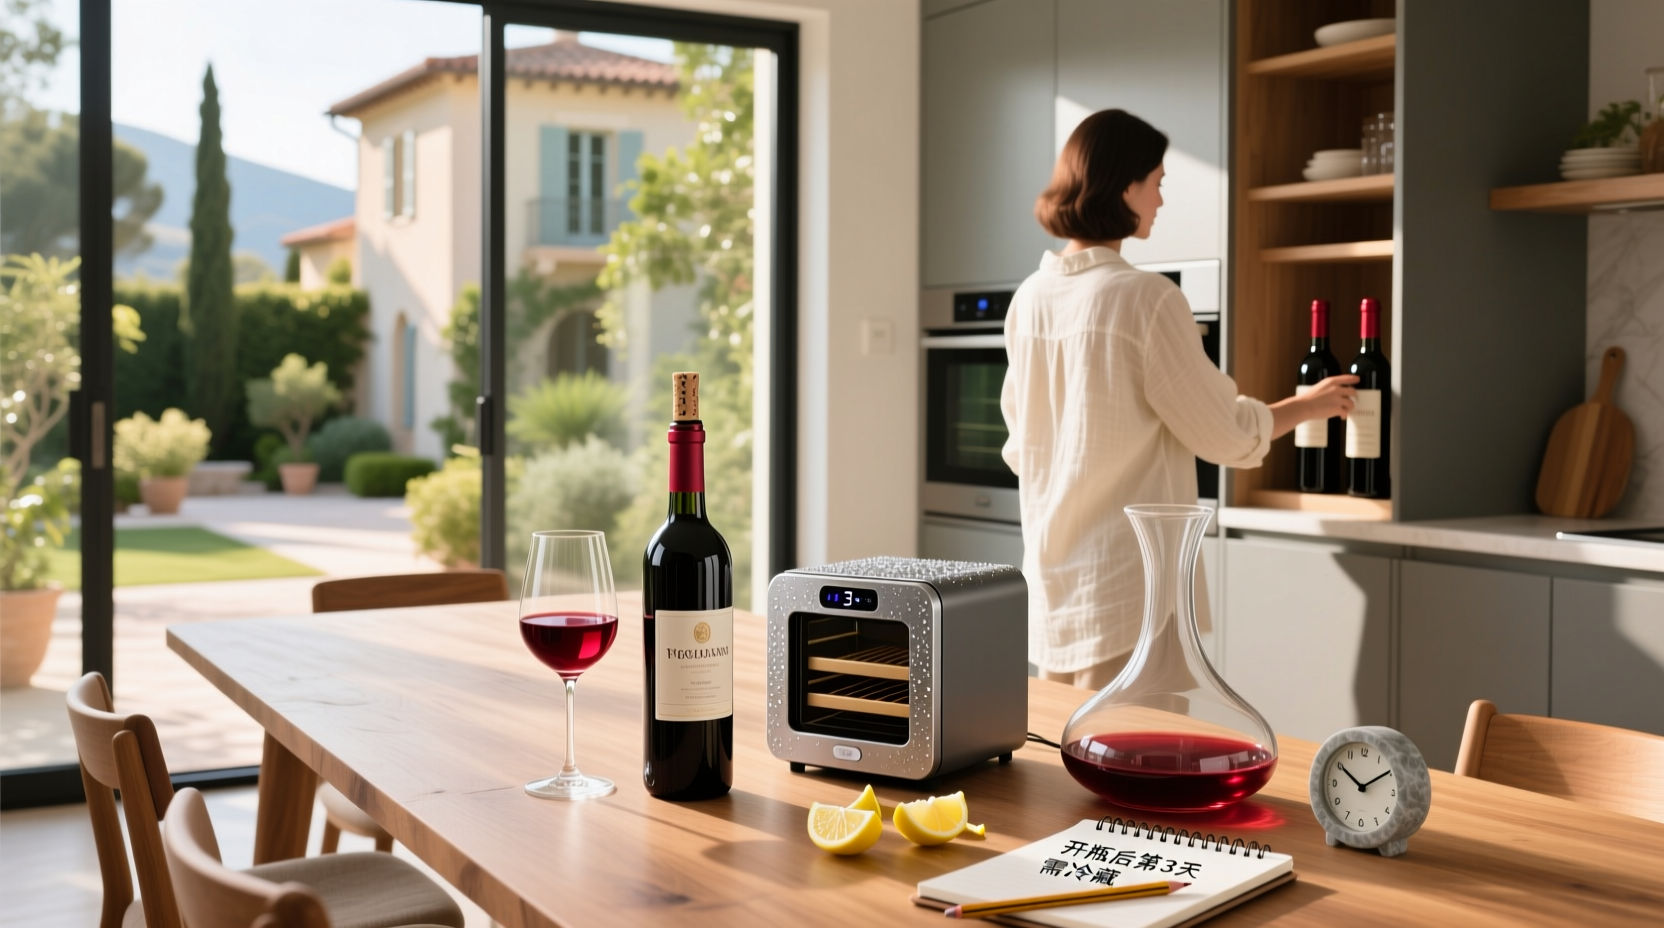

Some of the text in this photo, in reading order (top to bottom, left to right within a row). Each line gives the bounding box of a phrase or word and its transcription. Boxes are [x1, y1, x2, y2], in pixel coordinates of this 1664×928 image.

[843, 591, 853, 607] 3
[1344, 810, 1351, 820] 7
[1061, 840, 1202, 879] 开瓶后第3天
[1040, 858, 1121, 886] 需冷藏
